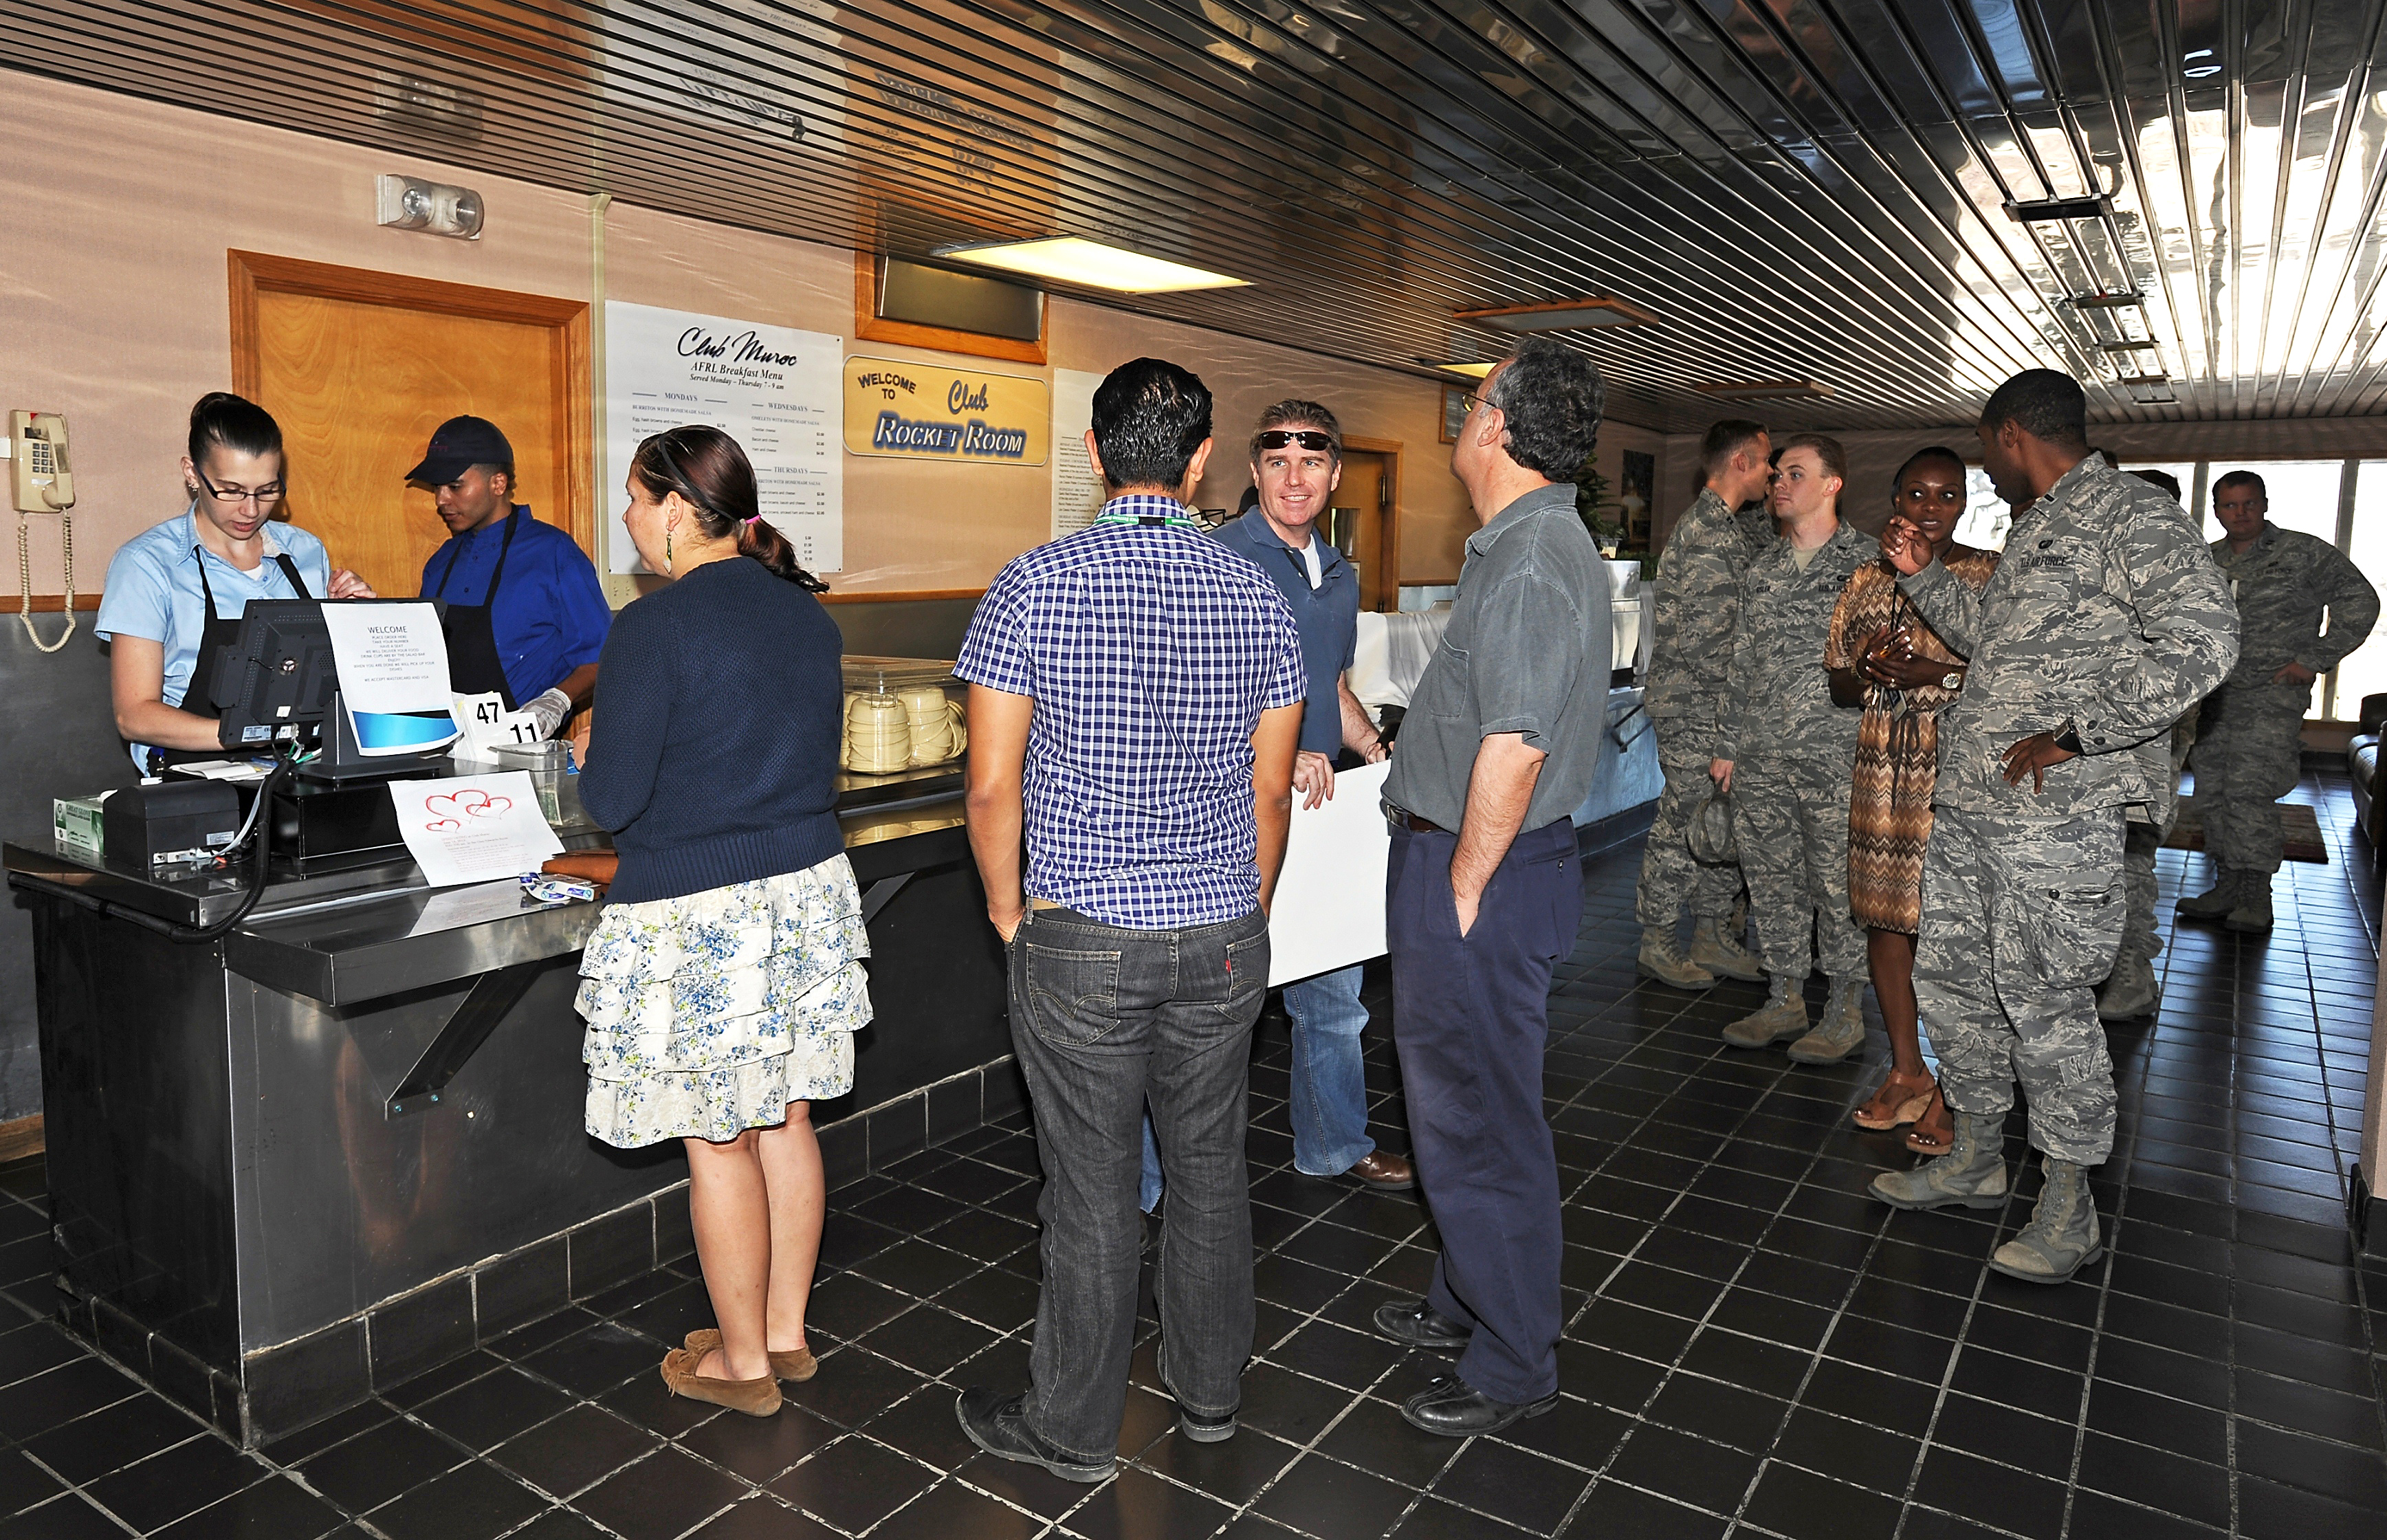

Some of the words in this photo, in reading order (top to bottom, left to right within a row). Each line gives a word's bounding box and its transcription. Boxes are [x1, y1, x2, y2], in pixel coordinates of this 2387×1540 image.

[677, 327, 730, 358] Club
[732, 331, 797, 366] Muroc
[691, 362, 717, 373] AFRL
[720, 364, 758, 378] Breakfast
[760, 369, 783, 380] Menu
[690, 373, 709, 382] Served
[710, 376, 732, 386] Monday
[738, 379, 762, 388] Thursday
[857, 372, 916, 395] WELCOME
[665, 393, 698, 402] MONDAYS
[881, 388, 895, 399] TO
[948, 380, 989, 415] Club
[768, 402, 808, 412] WEDNESDAYS
[774, 466, 808, 474] THURSDAYS
[477, 702, 498, 724] 47
[510, 723, 537, 743] 11
